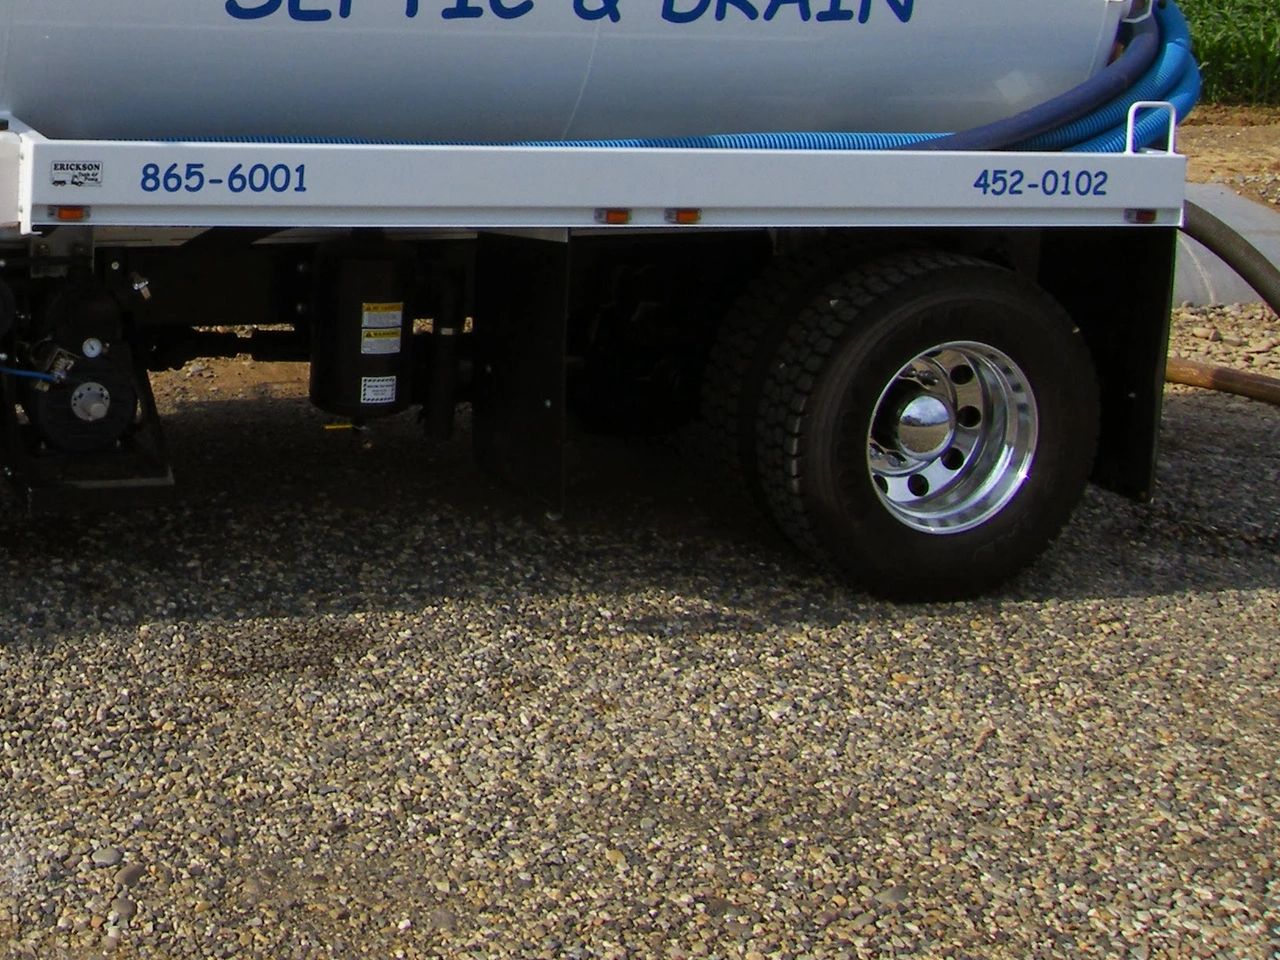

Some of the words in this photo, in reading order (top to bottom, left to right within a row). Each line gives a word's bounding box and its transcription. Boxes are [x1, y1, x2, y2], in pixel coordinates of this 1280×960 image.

[53, 163, 100, 171] ERICKSON
[140, 163, 307, 193] 865-6001
[973, 169, 1109, 196] 452-0102
